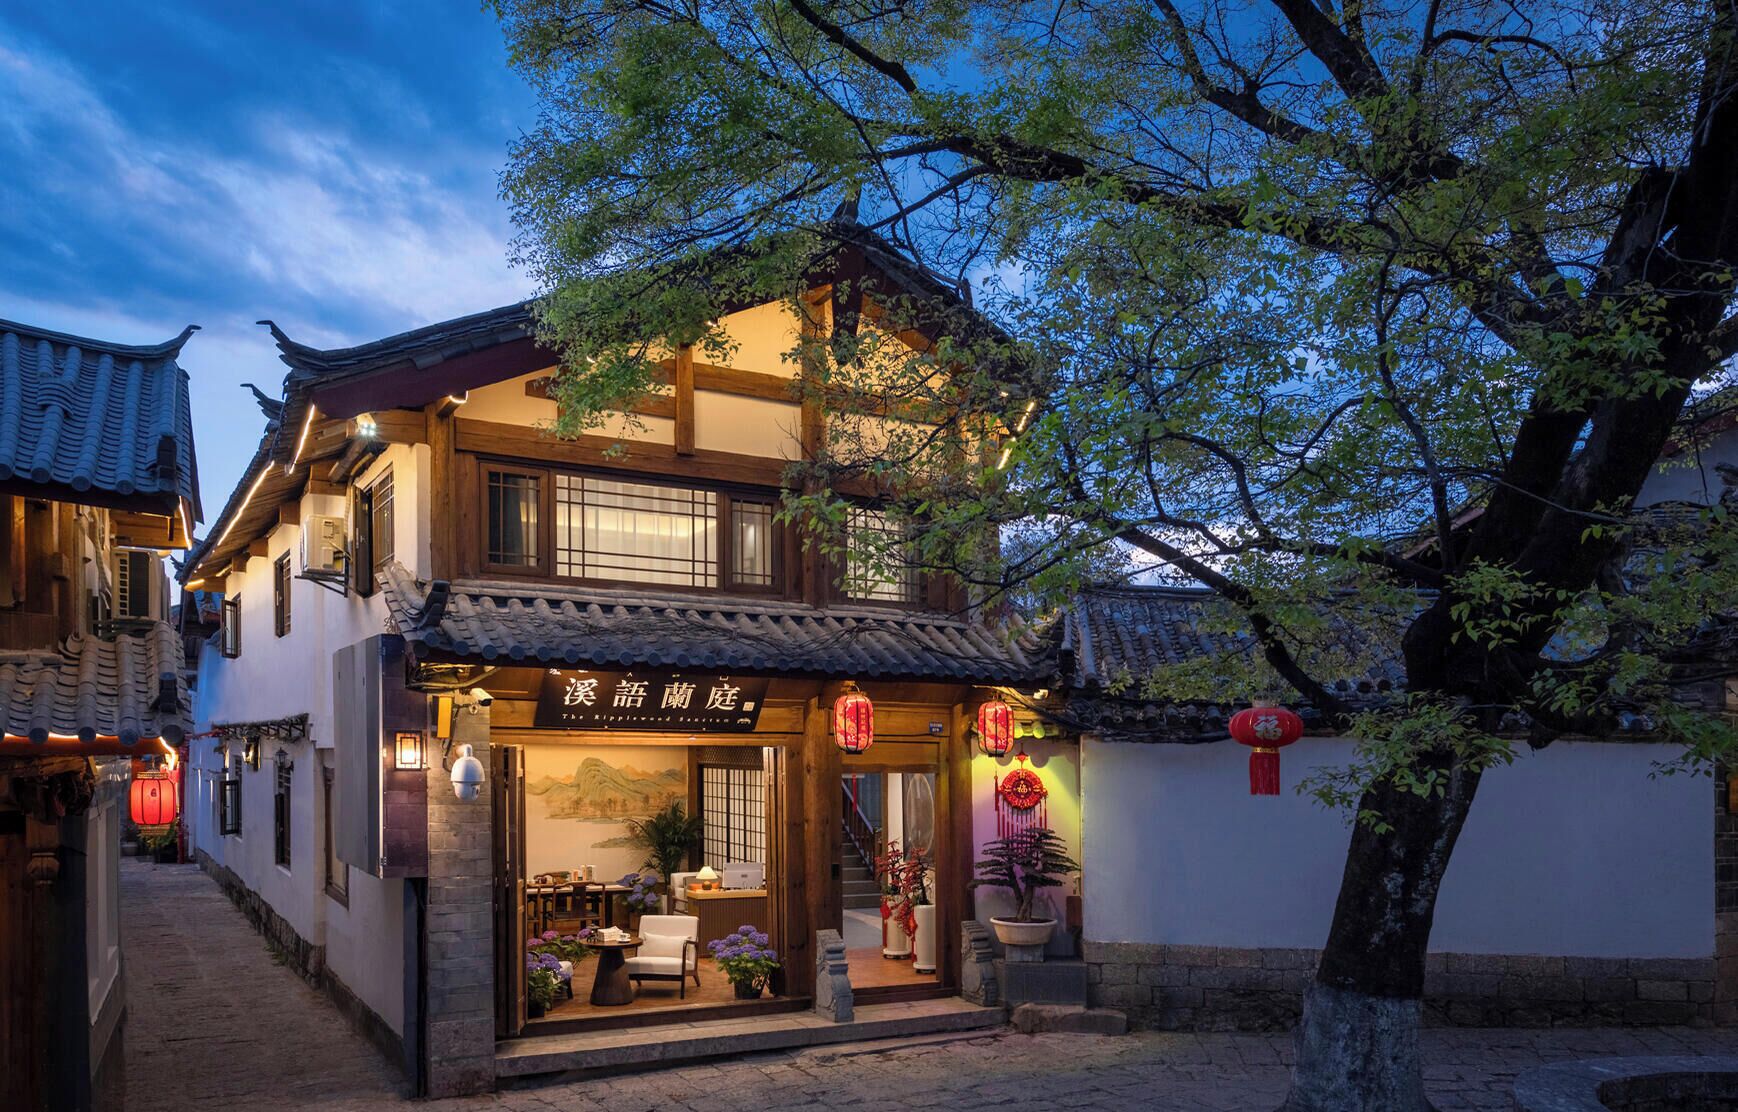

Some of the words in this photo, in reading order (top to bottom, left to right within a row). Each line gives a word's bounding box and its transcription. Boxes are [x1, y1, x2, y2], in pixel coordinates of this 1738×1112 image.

[564, 677, 741, 711] 溪語蘭庭
[1253, 715, 1282, 740] 福
